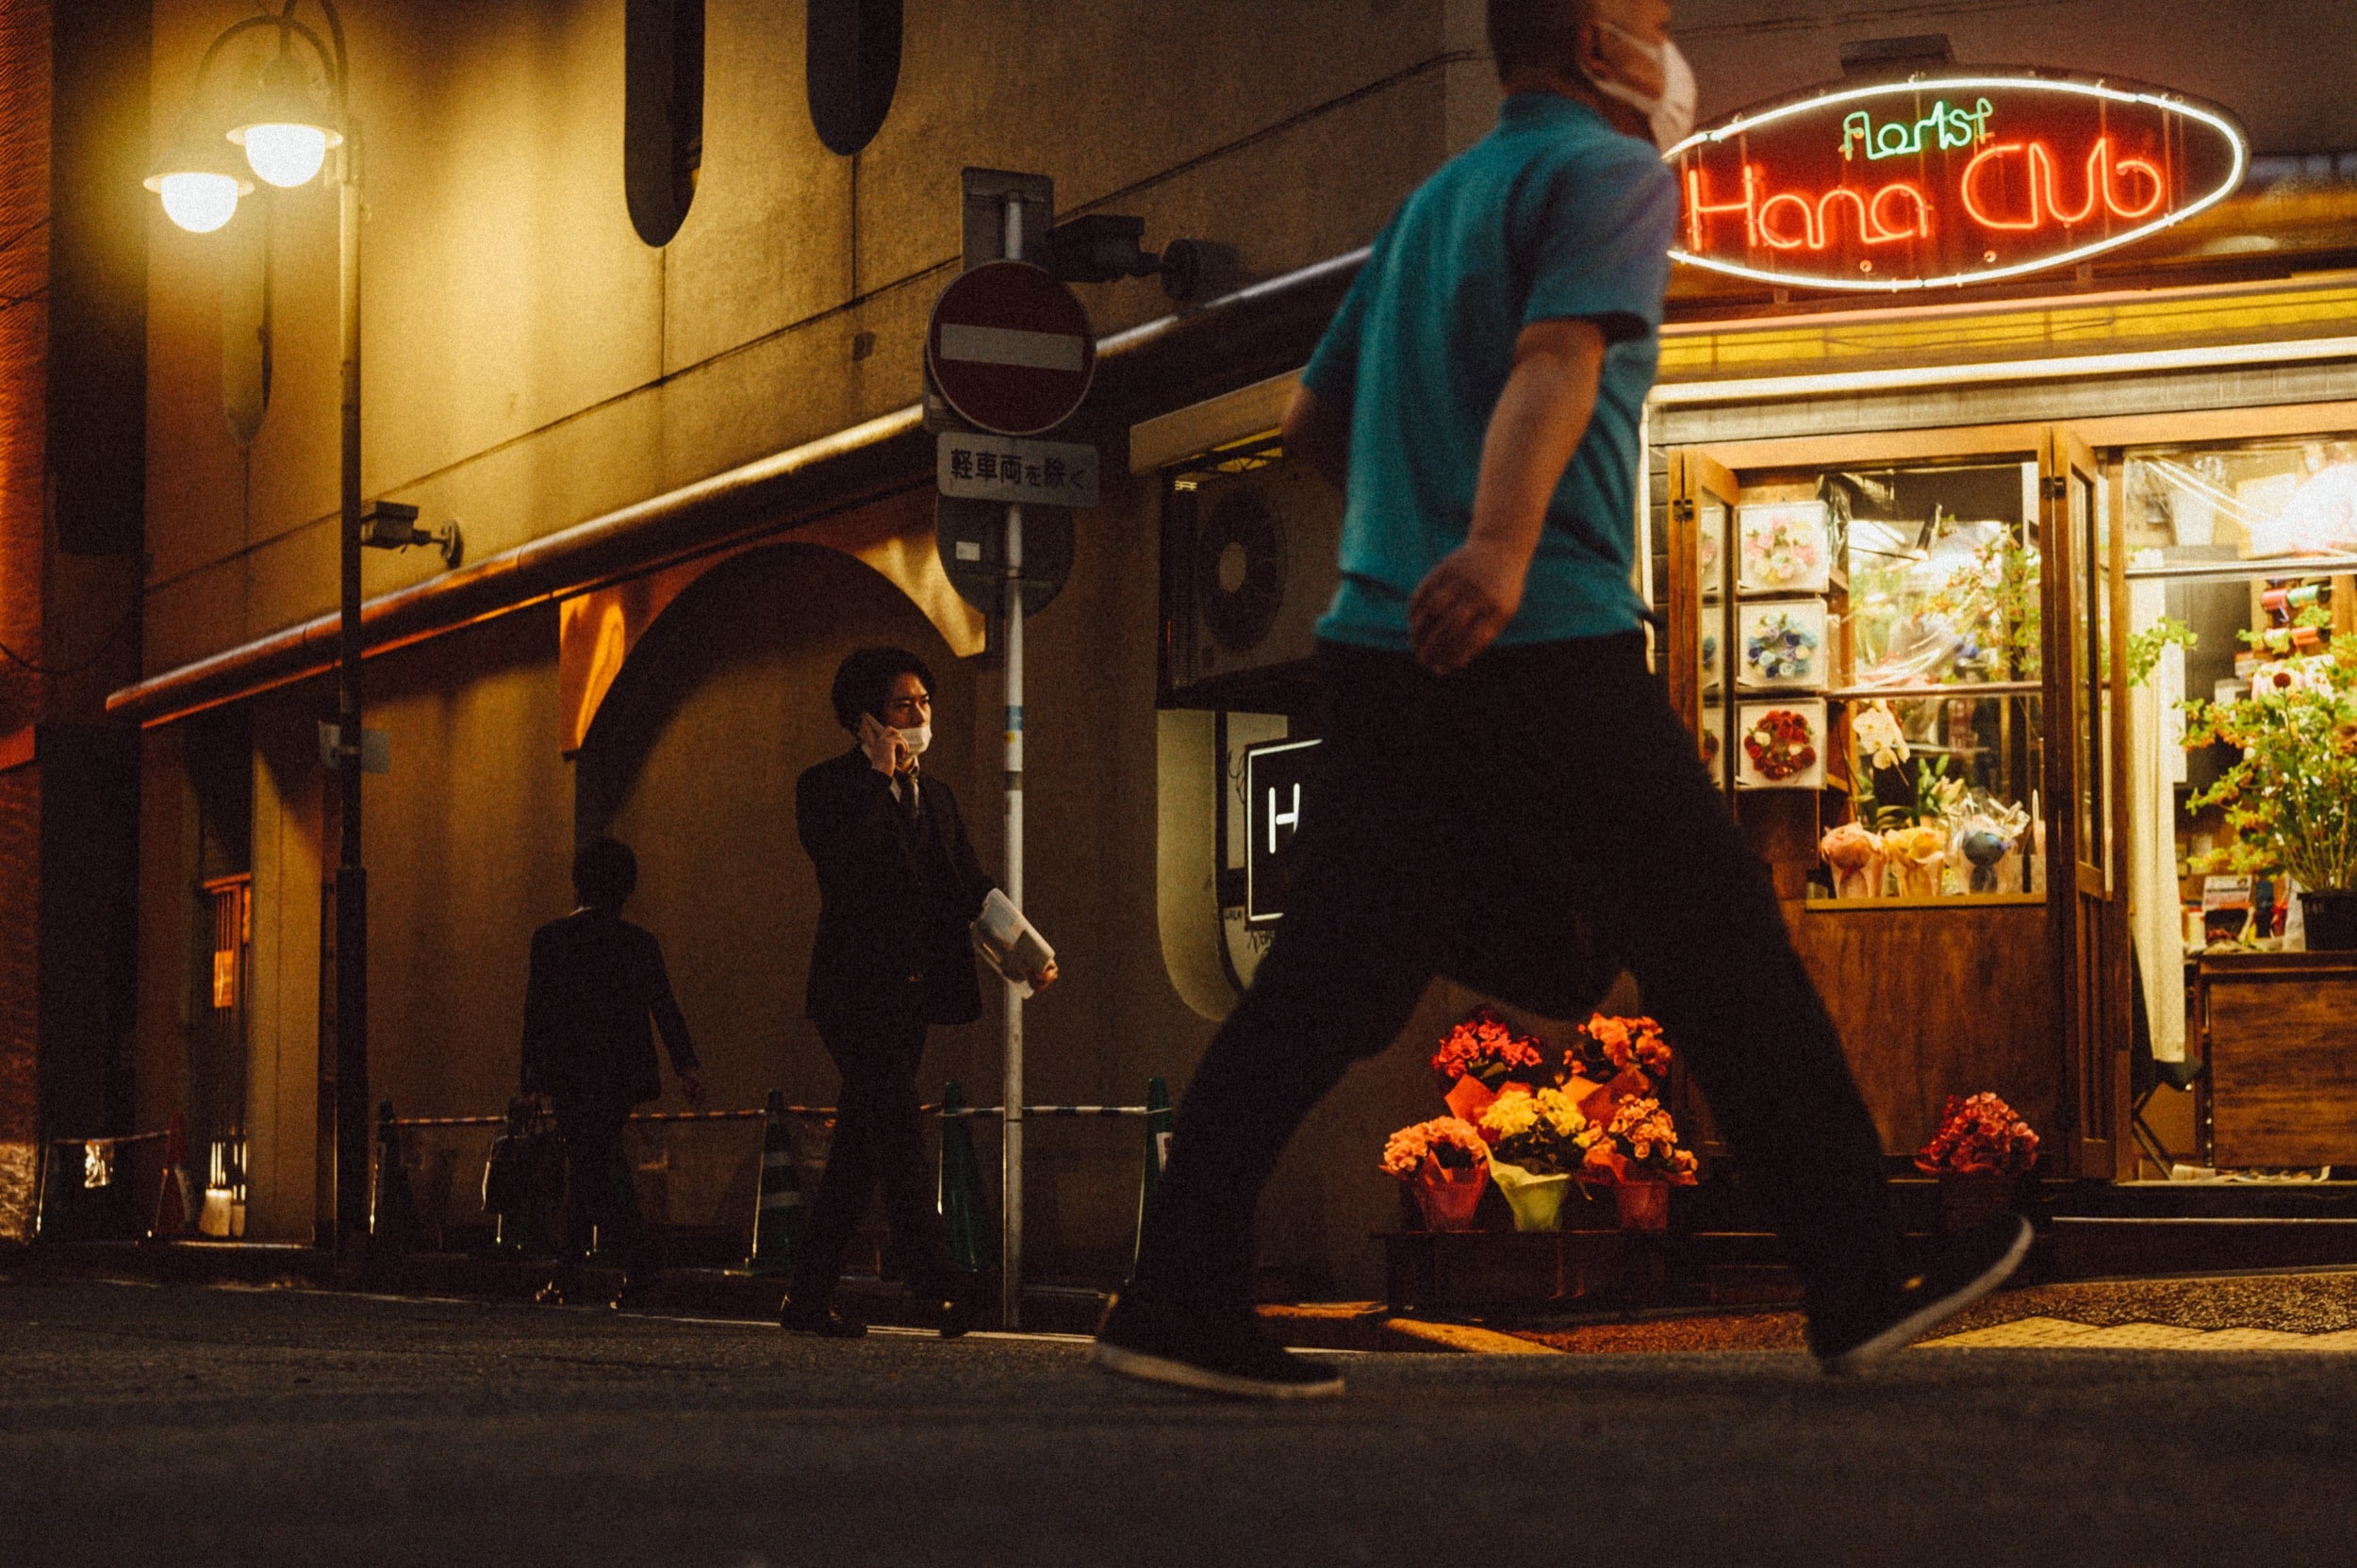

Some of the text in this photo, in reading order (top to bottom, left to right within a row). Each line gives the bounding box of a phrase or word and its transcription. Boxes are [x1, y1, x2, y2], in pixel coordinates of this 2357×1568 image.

[1688, 137, 2165, 251] Hana Club
[949, 447, 1087, 490] 軽車両を除く
